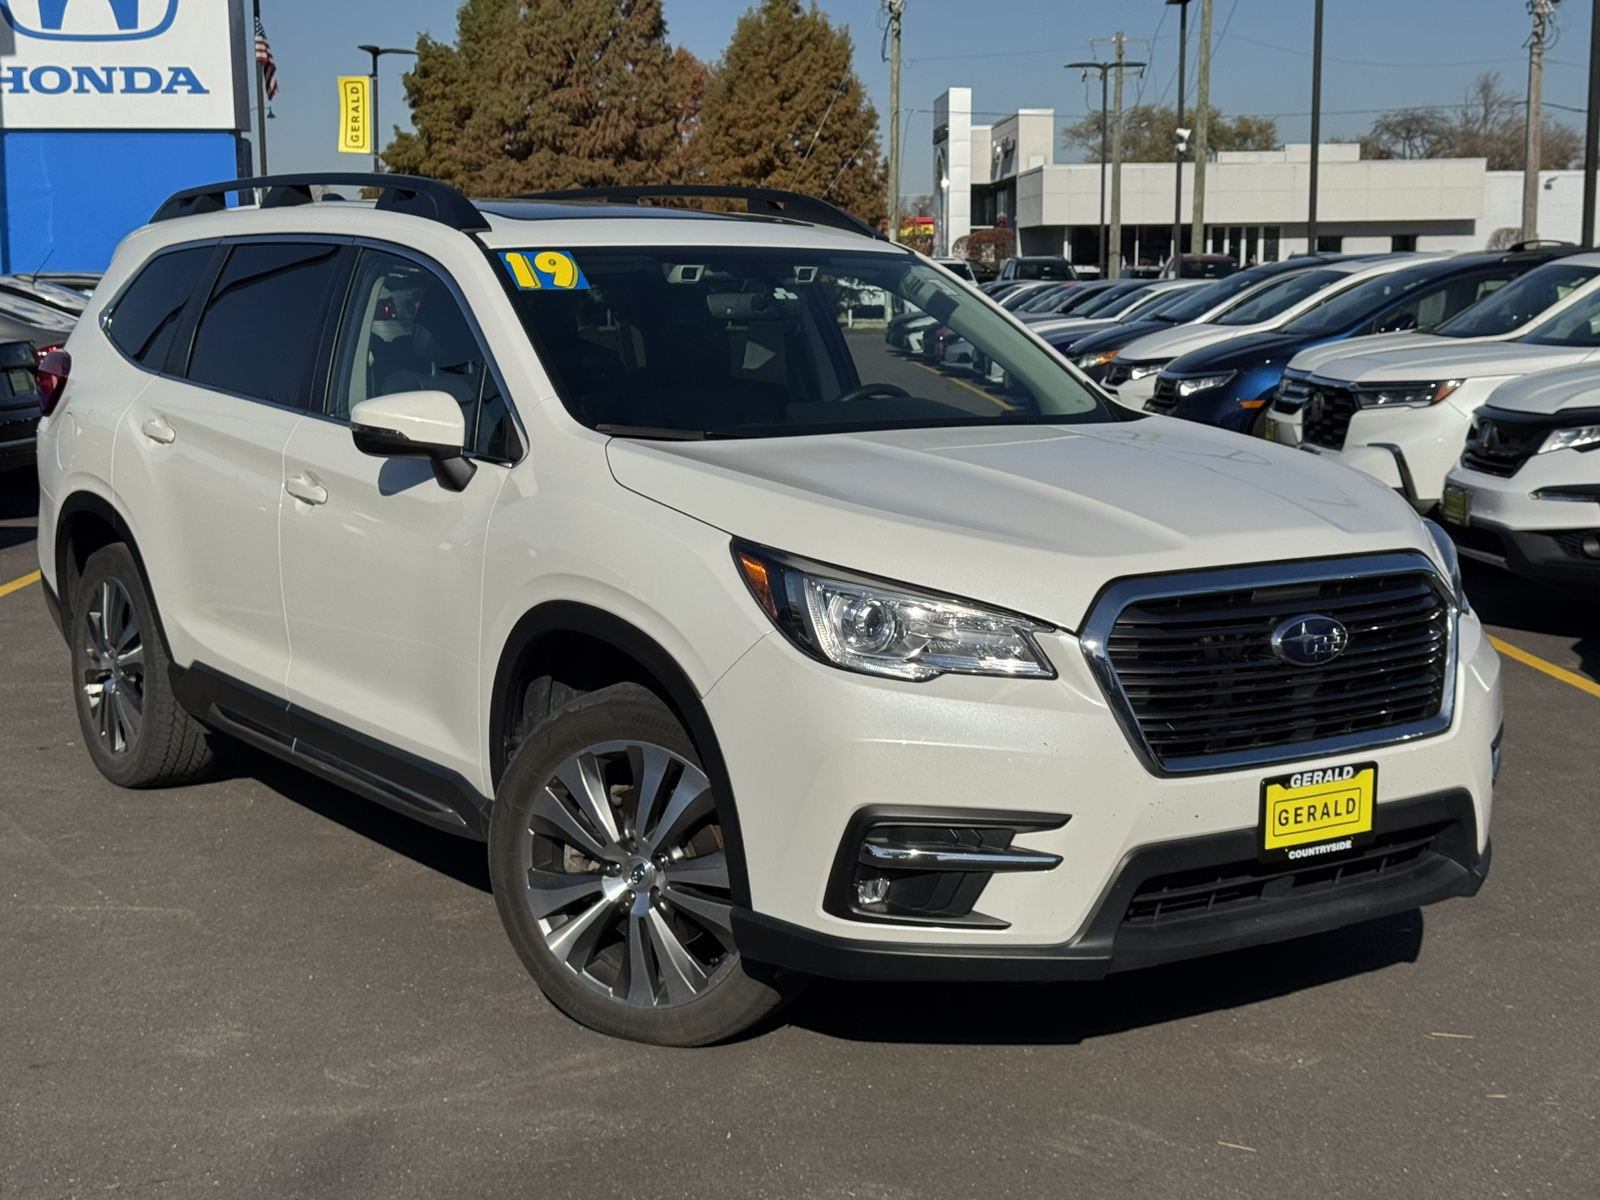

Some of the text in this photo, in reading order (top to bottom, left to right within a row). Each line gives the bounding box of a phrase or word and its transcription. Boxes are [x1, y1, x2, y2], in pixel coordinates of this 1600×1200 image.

[0, 66, 210, 94] HONDA
[350, 86, 360, 142] GERALD
[505, 251, 579, 290] 19
[1290, 766, 1354, 788] GERALD
[1278, 797, 1356, 827] GERALD
[1288, 840, 1352, 860] COUNTRYSIDE
